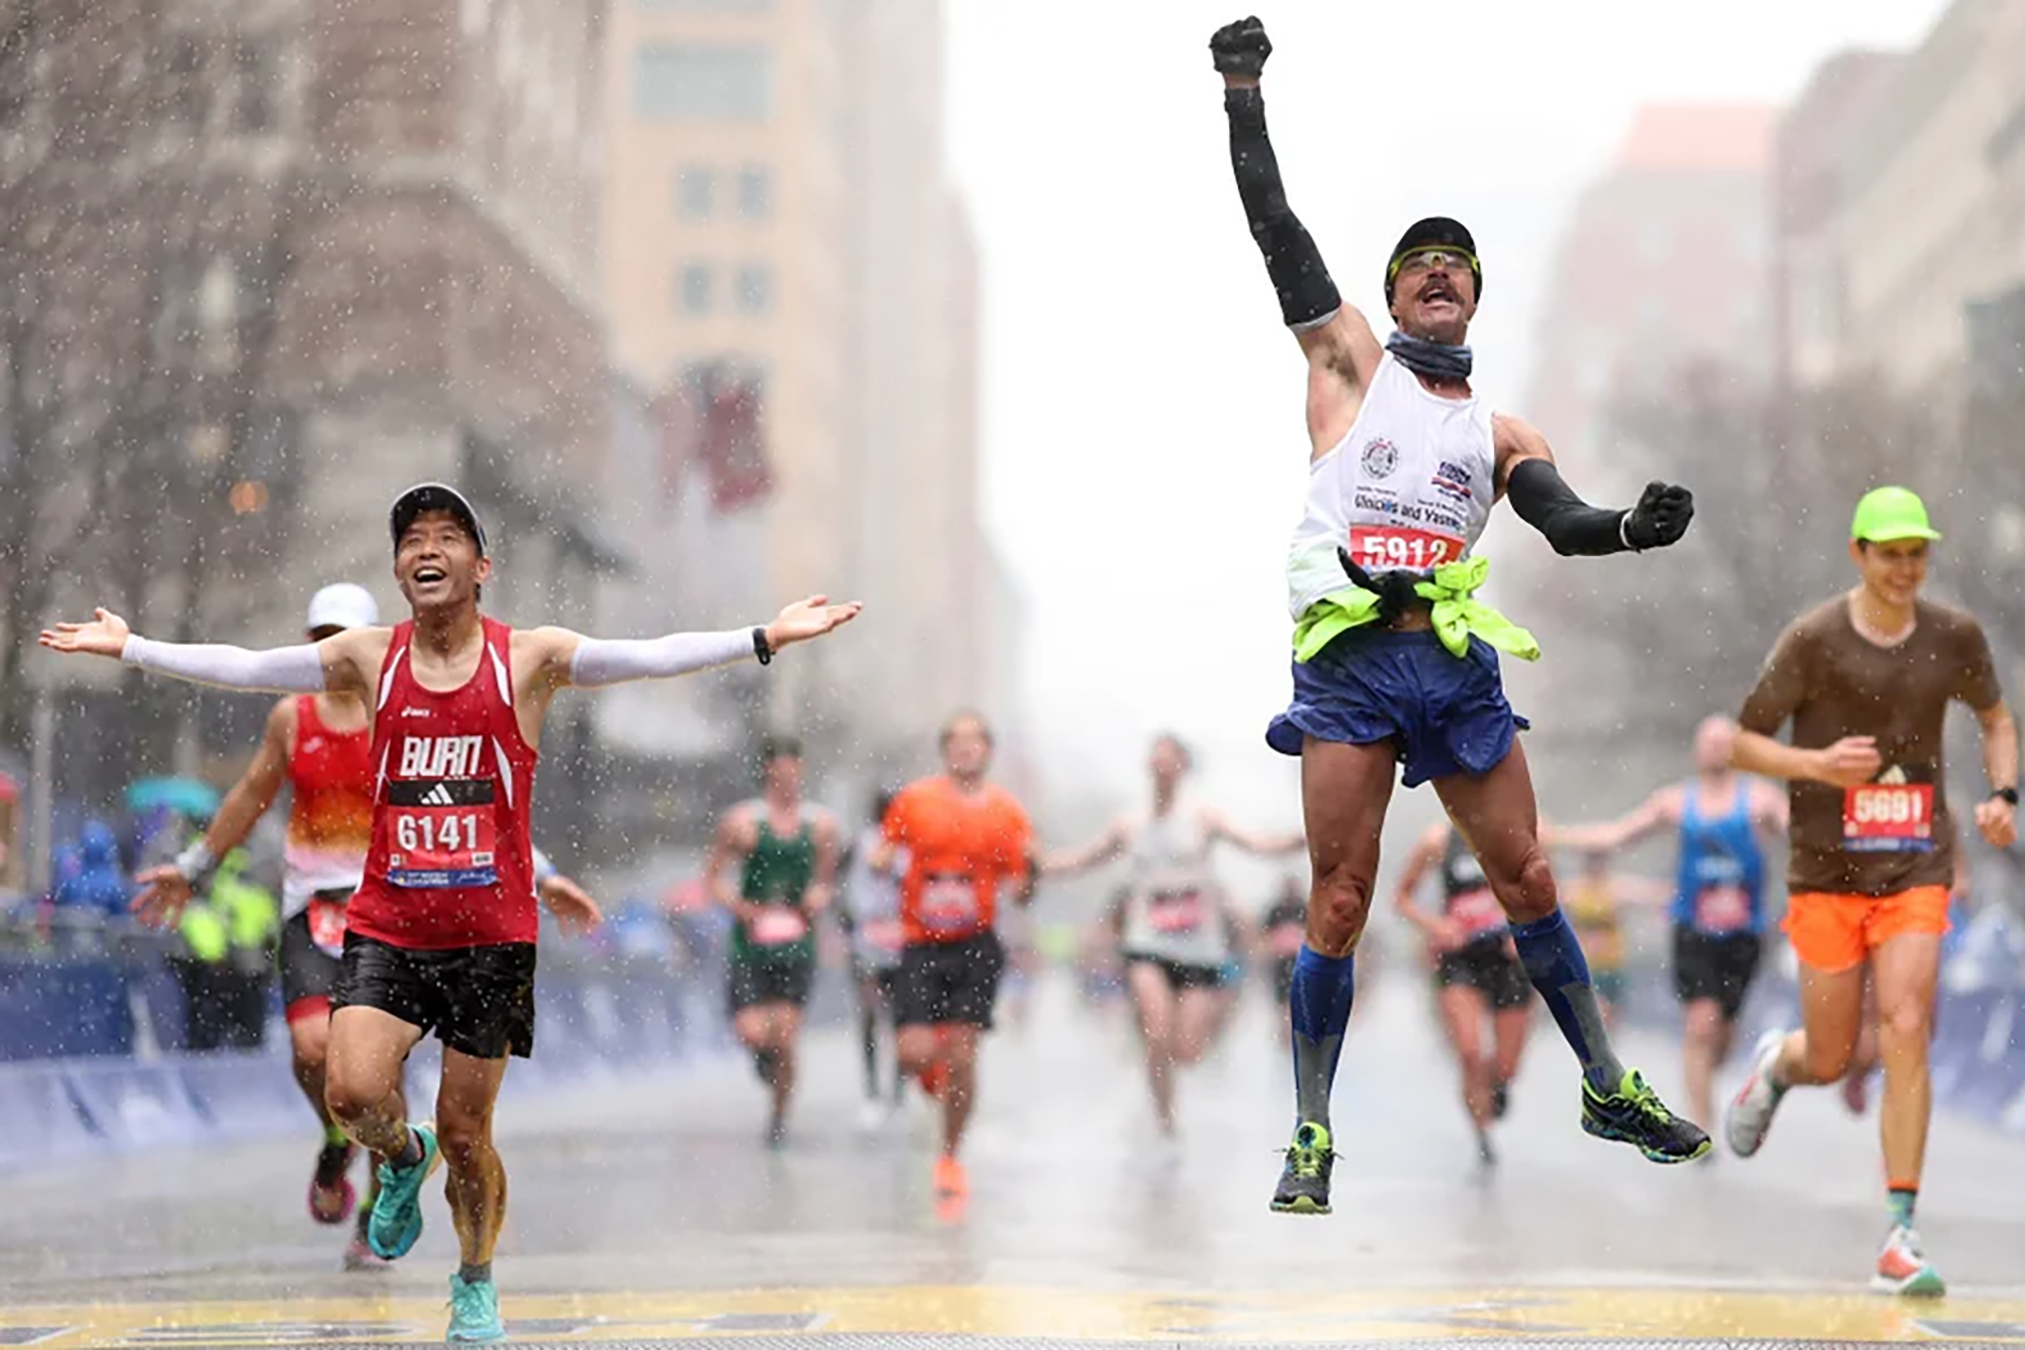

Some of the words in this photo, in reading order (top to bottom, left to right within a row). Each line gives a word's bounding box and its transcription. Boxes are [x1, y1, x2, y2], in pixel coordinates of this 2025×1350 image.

[1400, 505, 1421, 521] and
[1362, 536, 1448, 567] 5912
[399, 735, 482, 776] BURN
[398, 815, 477, 851] 6141
